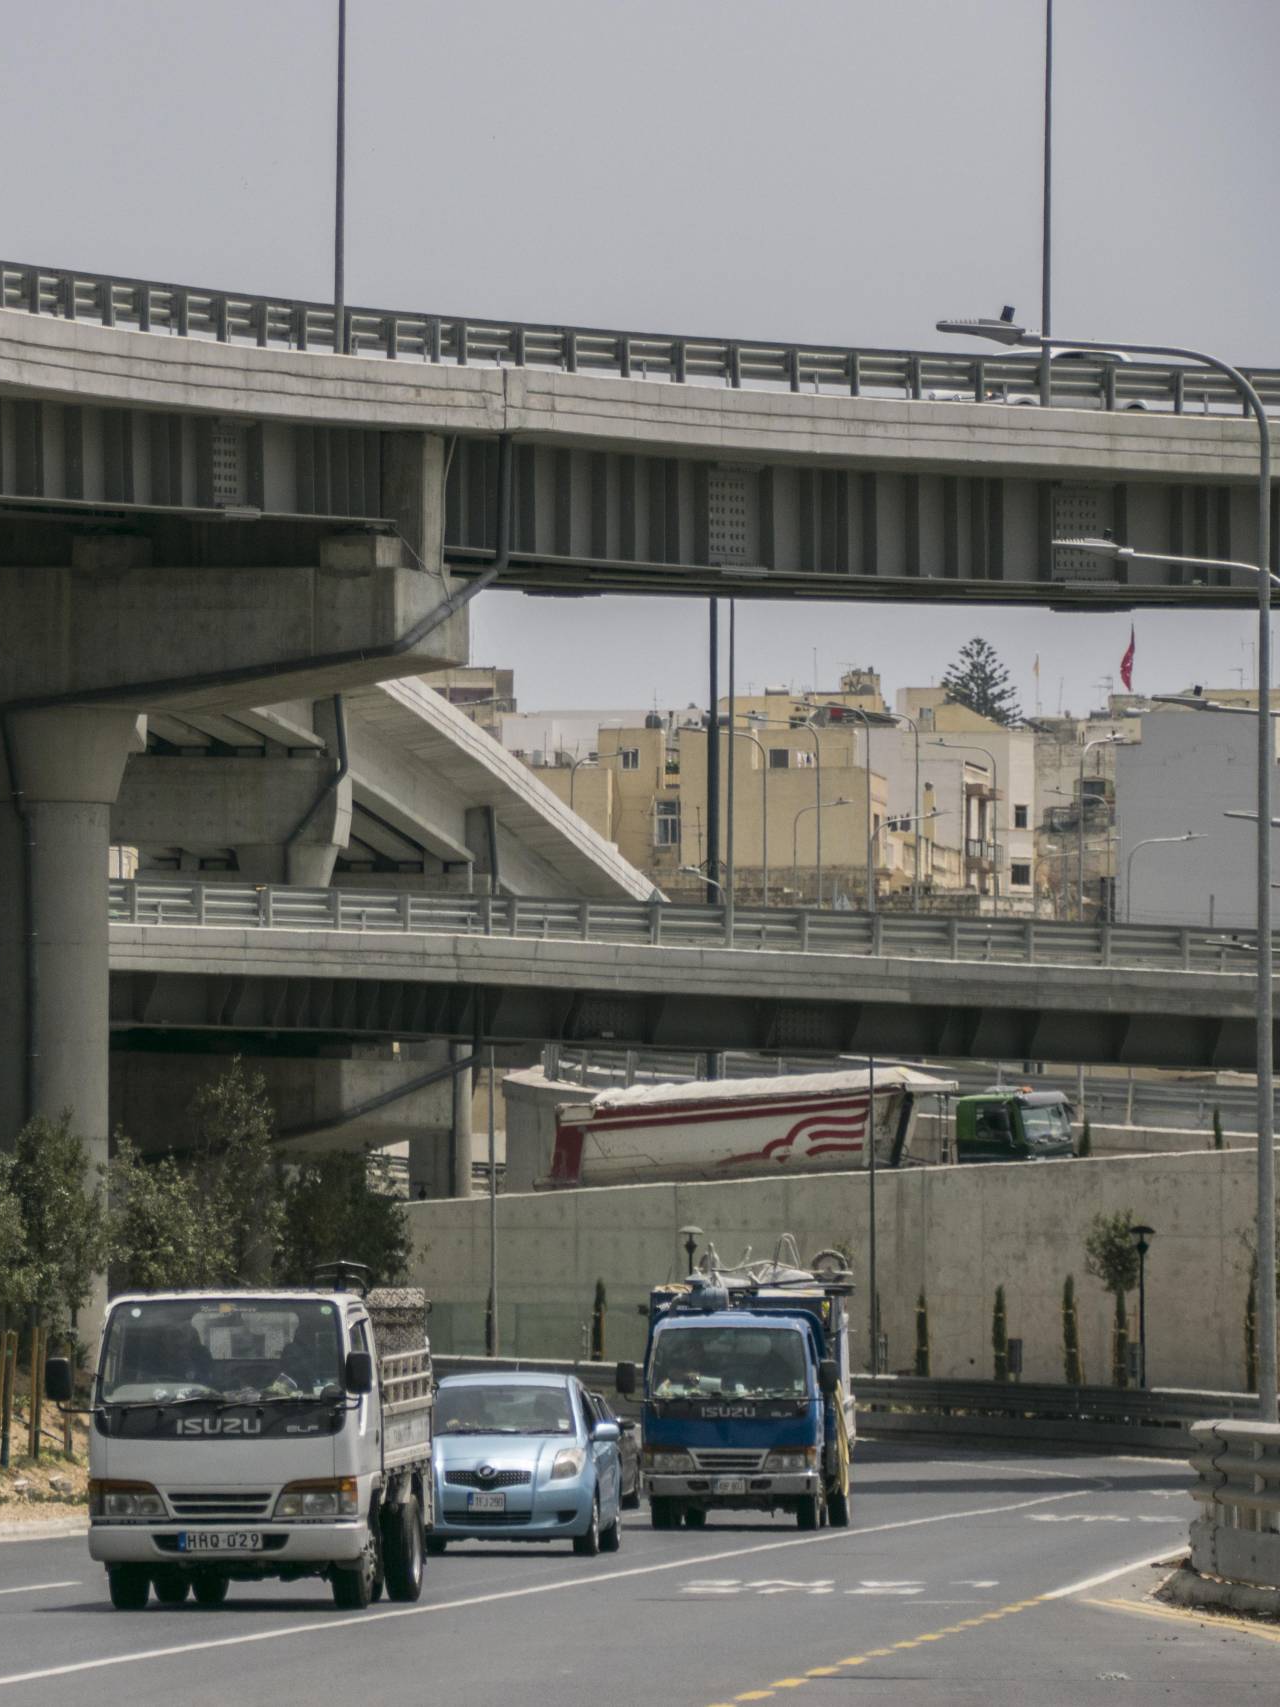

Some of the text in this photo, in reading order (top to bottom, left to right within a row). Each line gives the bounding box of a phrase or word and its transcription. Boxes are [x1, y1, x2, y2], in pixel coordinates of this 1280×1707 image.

[701, 1407, 756, 1417] ISUZU
[176, 1418, 261, 1434] ISUZU
[227, 1533, 260, 1547] 029
